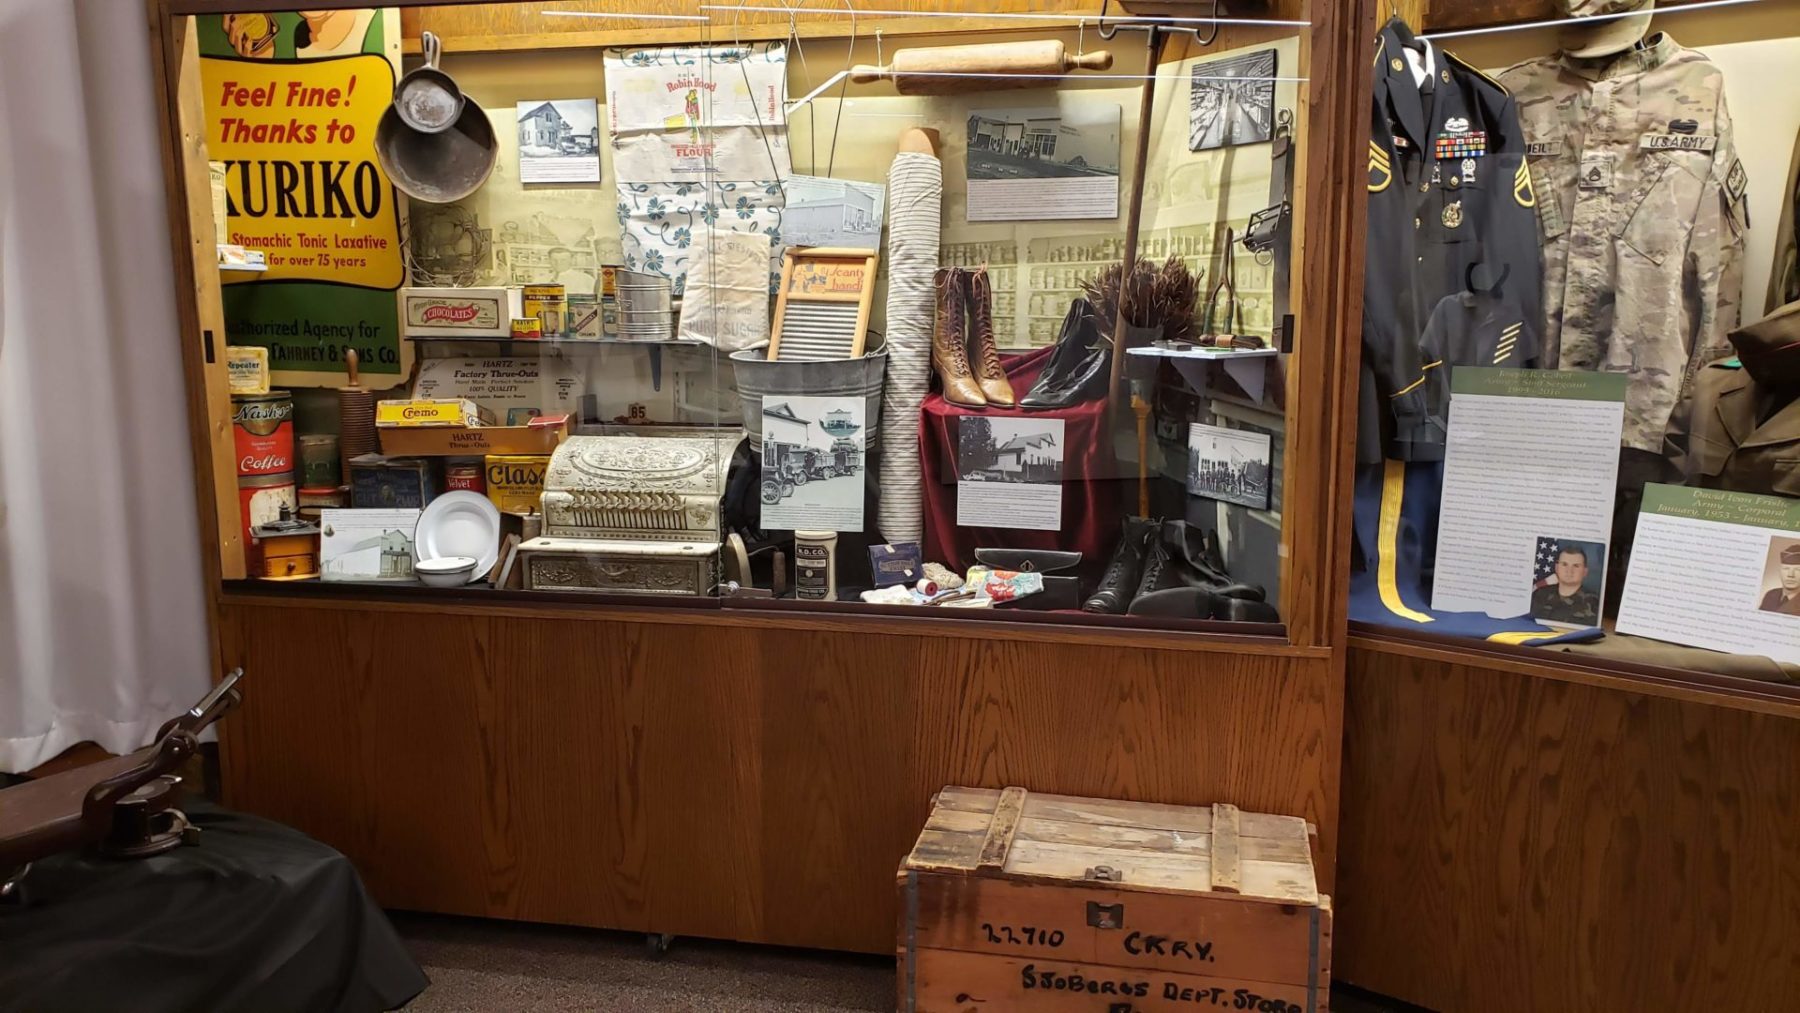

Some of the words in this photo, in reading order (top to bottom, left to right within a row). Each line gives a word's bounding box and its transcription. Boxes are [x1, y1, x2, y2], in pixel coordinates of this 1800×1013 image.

[220, 81, 276, 107] Feel
[285, 74, 357, 107] Fine!
[666, 78, 693, 92] Robin
[694, 77, 717, 92] Hood
[220, 118, 317, 144] Thanks
[326, 118, 355, 144] to
[676, 148, 712, 157] FLOUR
[224, 160, 382, 218] KURIKO
[232, 232, 292, 248] Stomachic
[297, 232, 328, 248] Tonic
[335, 233, 388, 249] Laxative
[268, 252, 286, 266] for
[289, 256, 315, 266] over
[317, 253, 330, 266] 75
[334, 257, 367, 269] years
[427, 307, 473, 319] CHOCOLATES
[303, 318, 355, 342] Agency
[358, 320, 381, 338] for
[328, 344, 338, 362] &
[482, 360, 514, 368] HARTZ
[454, 369, 488, 379] Factory
[487, 385, 517, 393] QUALITY
[402, 407, 439, 420] Cremo
[452, 432, 485, 442] HARTZ
[240, 454, 286, 472] Coffee
[448, 479, 471, 489] Velvet
[1693, 490, 1725, 501] David
[1657, 503, 1701, 516] January,
[1691, 500, 1724, 511] Army
[1738, 503, 1787, 518] Corporal
[981, 923, 1065, 948] 22710
[1163, 981, 1229, 1008] DEPT.
